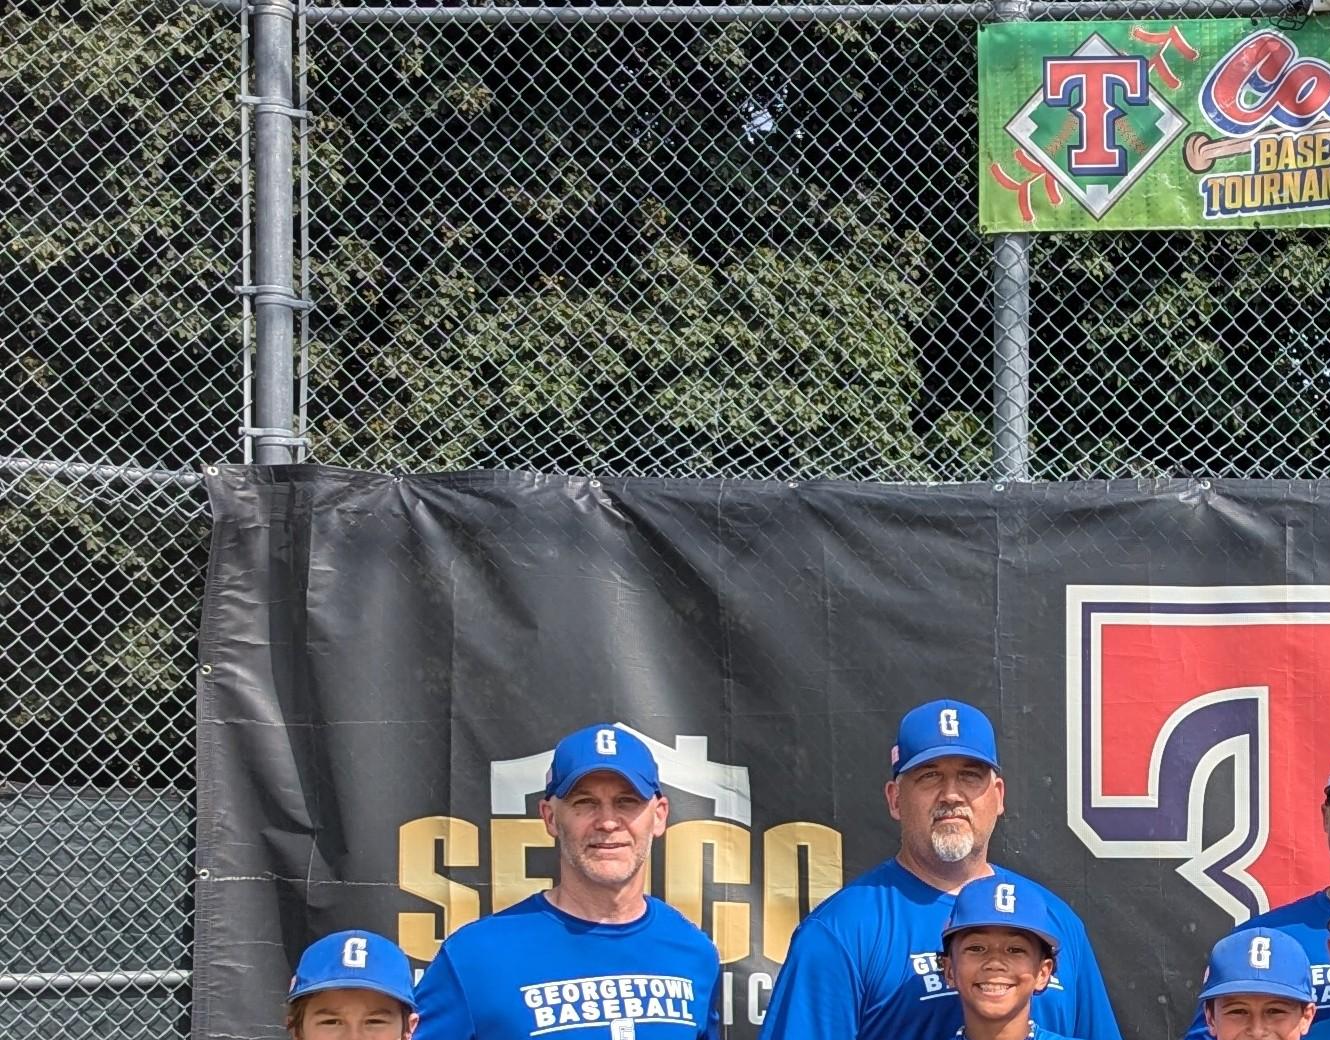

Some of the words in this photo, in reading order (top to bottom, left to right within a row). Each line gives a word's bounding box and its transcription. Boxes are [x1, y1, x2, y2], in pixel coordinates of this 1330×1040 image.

[1041, 55, 1149, 177] T
[939, 709, 959, 737] G
[596, 729, 617, 755] G
[398, 814, 843, 966] SECO
[994, 883, 1016, 913] G
[342, 937, 368, 969] G
[1249, 936, 1271, 969] G
[524, 978, 694, 1008] GEORGETOWN
[535, 998, 693, 1028] BASEBALL
